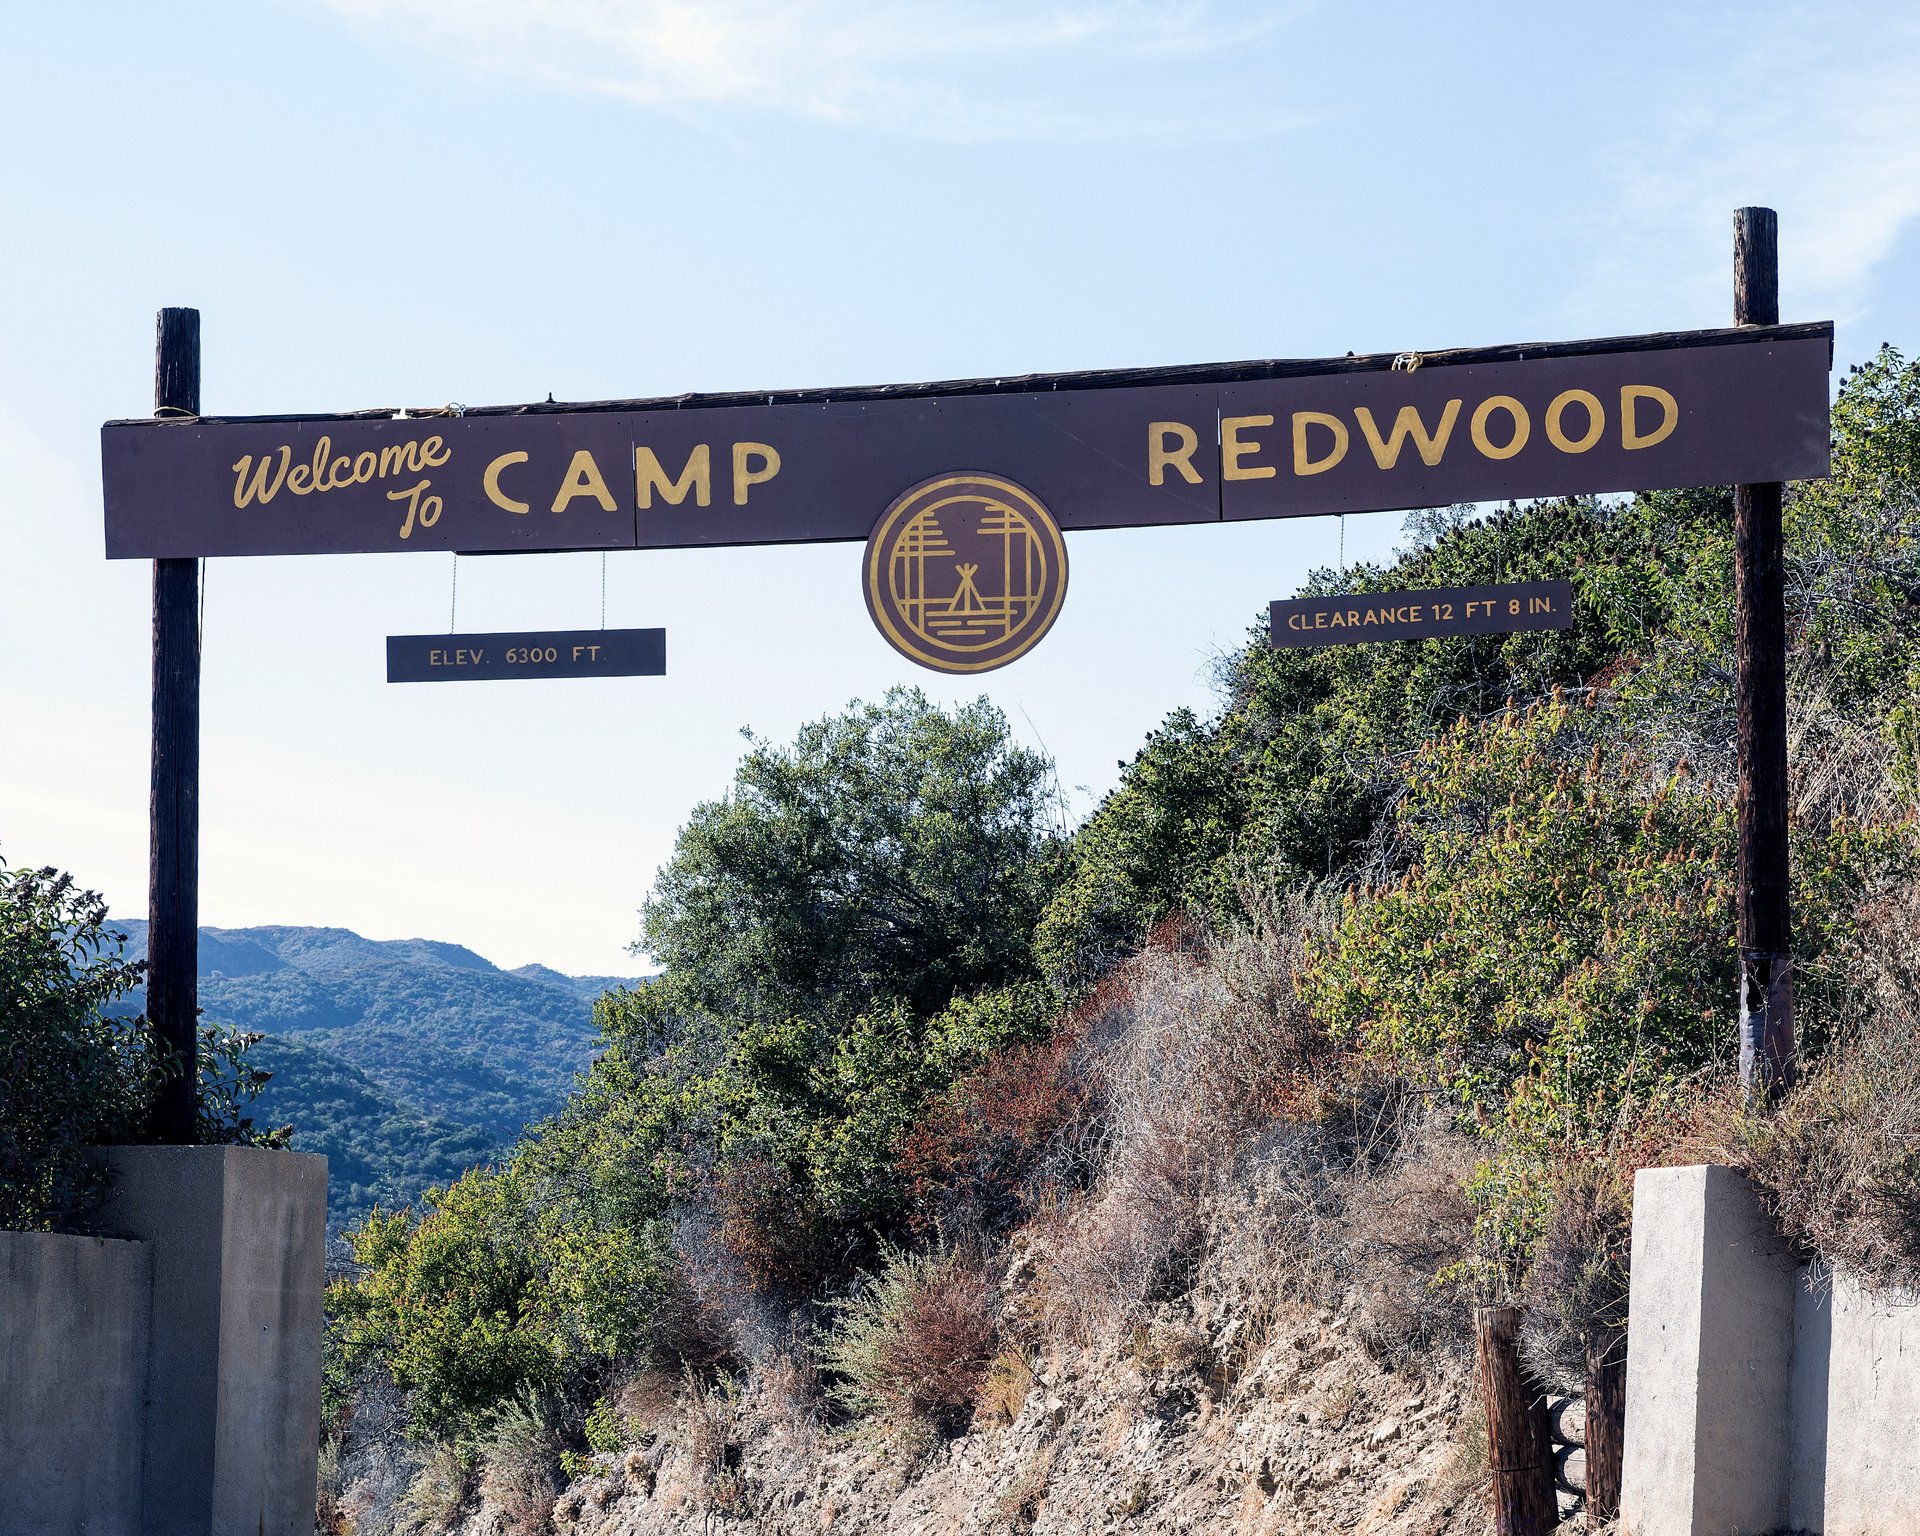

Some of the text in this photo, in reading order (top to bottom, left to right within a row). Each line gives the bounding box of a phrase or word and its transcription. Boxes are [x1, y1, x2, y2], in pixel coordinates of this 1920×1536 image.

[231, 435, 452, 509] Welcome
[482, 384, 1680, 514] CAMP REDWOOD
[386, 479, 443, 540] To
[1287, 596, 1557, 631] CLEARANCE 12 FT 8 IN.
[429, 648, 491, 666] ELEV.
[505, 647, 558, 664] 6300
